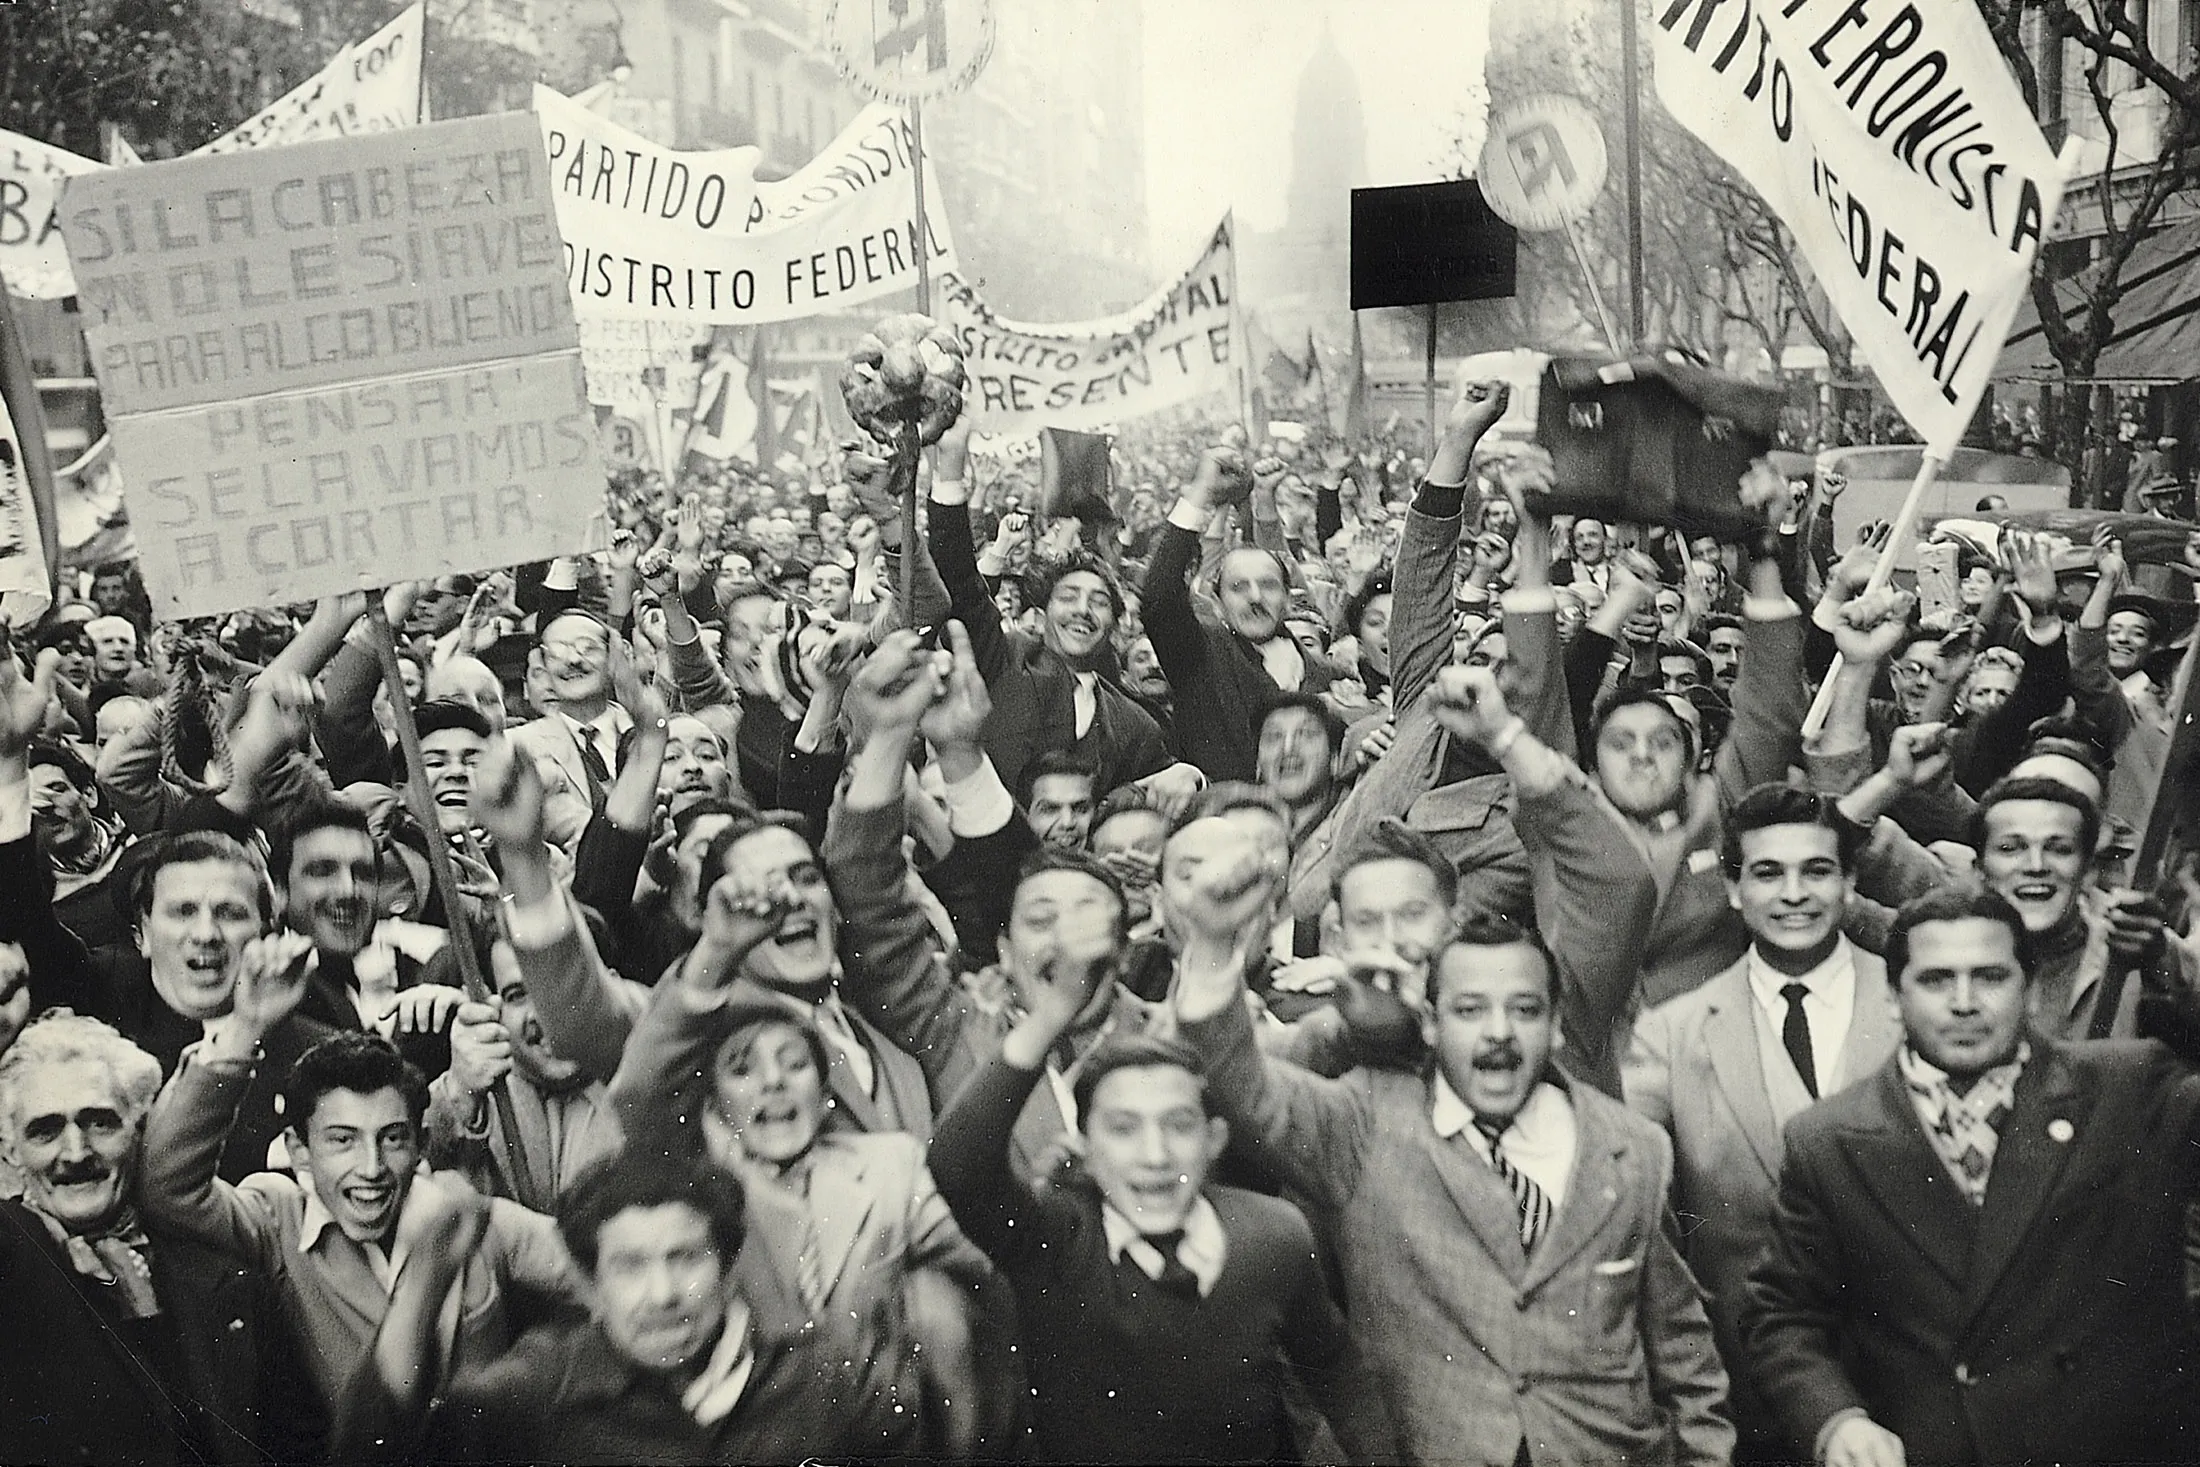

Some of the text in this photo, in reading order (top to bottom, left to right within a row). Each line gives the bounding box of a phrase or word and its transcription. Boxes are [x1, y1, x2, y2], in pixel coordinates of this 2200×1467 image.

[549, 116, 927, 233] PARTIDO PONISTA
[1782, 0, 2042, 253] ERONISTA
[271, 149, 532, 231] CABEZA
[786, 209, 948, 304] FEDERAL
[102, 283, 558, 390] PARA ALGO BUENO
[952, 322, 1079, 372] ISTRITO
[963, 322, 1230, 413] RESENTE
[207, 369, 500, 456] PENSAR
[148, 465, 248, 529] SE
[261, 450, 356, 508] LA
[370, 414, 589, 494] VAMOS
[175, 483, 534, 589] A CORTAR
